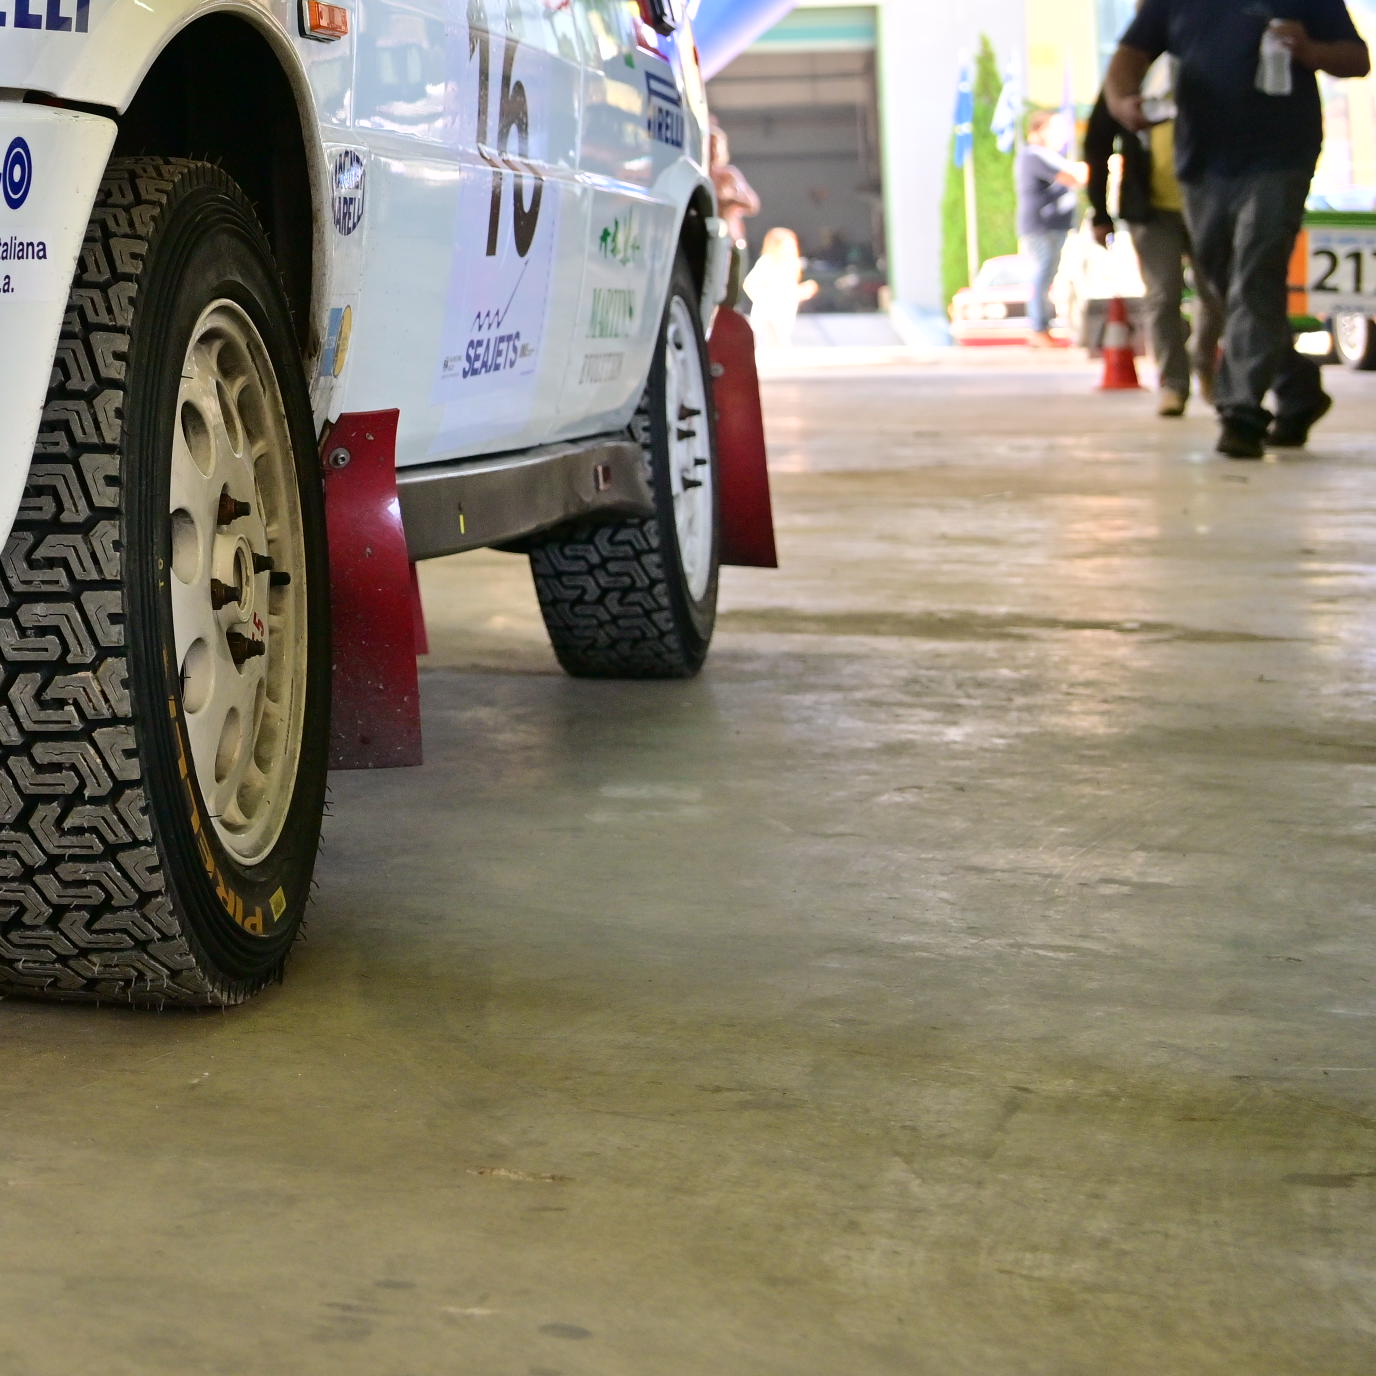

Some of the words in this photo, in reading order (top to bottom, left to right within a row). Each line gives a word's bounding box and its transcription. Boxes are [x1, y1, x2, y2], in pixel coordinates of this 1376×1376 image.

[645, 71, 684, 149] PIRELLI
[1311, 249, 1376, 293] 21
[462, 331, 521, 379] SEAJETS
